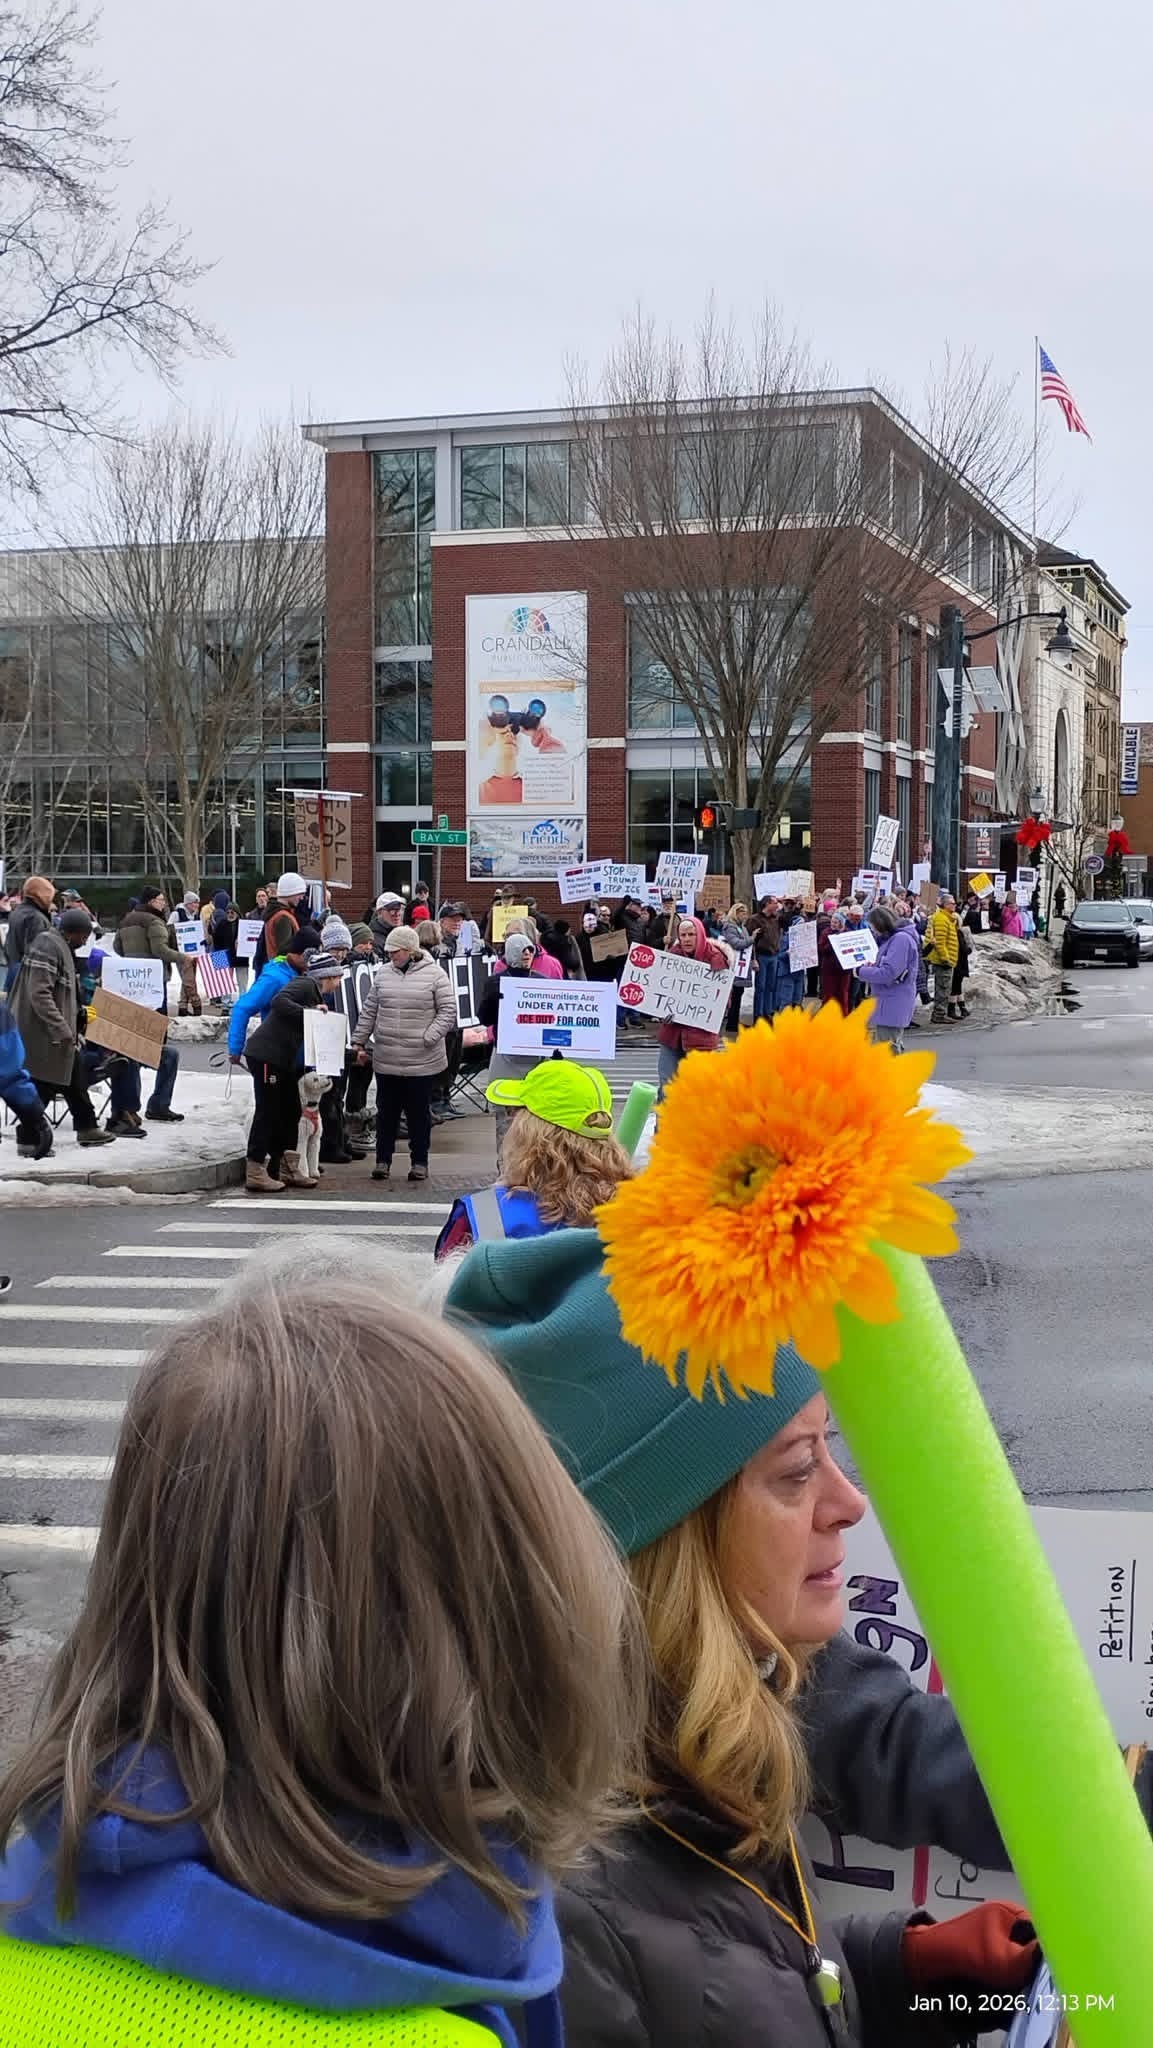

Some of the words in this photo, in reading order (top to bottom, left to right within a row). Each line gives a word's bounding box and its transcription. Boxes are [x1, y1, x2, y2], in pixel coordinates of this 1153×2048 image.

[481, 636, 571, 653] CRANDALL
[1124, 728, 1138, 780] AVAILABLE
[420, 832, 440, 843] BAY
[448, 833, 460, 843] ST
[522, 830, 570, 845] Friends
[979, 828, 989, 838] 16
[665, 855, 703, 867] DEPORT
[603, 865, 625, 877] STOP
[673, 866, 692, 878] THE
[608, 876, 637, 884] TRUMP
[603, 884, 622, 894] STOP
[624, 885, 640, 894] ICE
[630, 949, 654, 963] STOP
[117, 967, 153, 980] TRUMP
[522, 990, 579, 1001] Communities
[580, 993, 595, 1002] Are
[620, 988, 644, 1001] STOP
[517, 1001, 554, 1010] UNDER
[556, 1003, 599, 1012] ATTACK
[519, 1014, 534, 1024] ICE
[535, 1014, 553, 1024] OUT
[556, 1015, 574, 1026] FOR
[576, 1016, 600, 1027] GOOD
